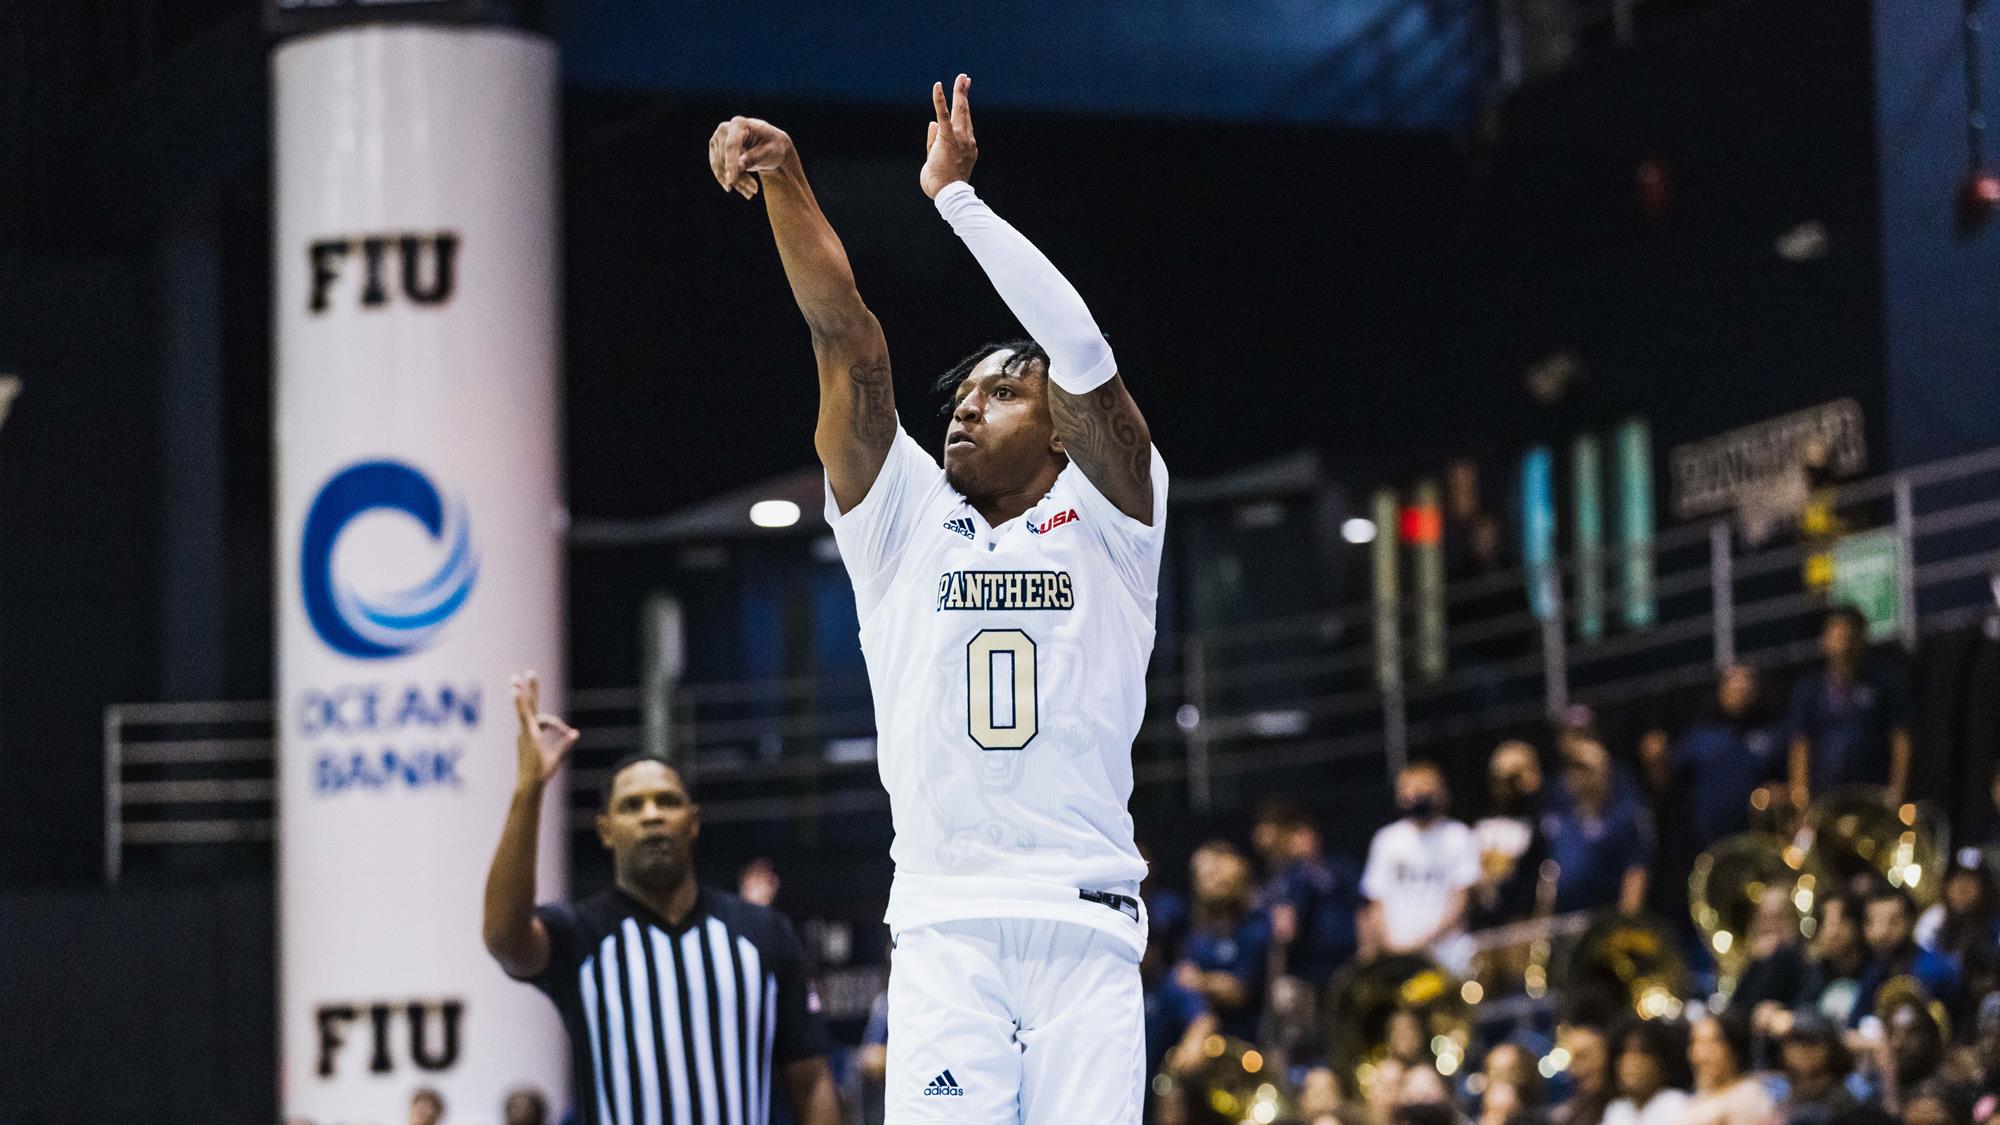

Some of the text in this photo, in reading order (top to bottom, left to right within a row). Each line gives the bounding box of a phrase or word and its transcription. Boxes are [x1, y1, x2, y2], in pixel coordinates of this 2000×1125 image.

[306, 231, 460, 316] FIU
[943, 522, 974, 540] adida
[937, 571, 1074, 611] PANTHERS
[967, 628, 1038, 751] 0
[314, 746, 465, 794] BANK
[315, 999, 463, 1077] FIU
[923, 1085, 964, 1096] adidas
